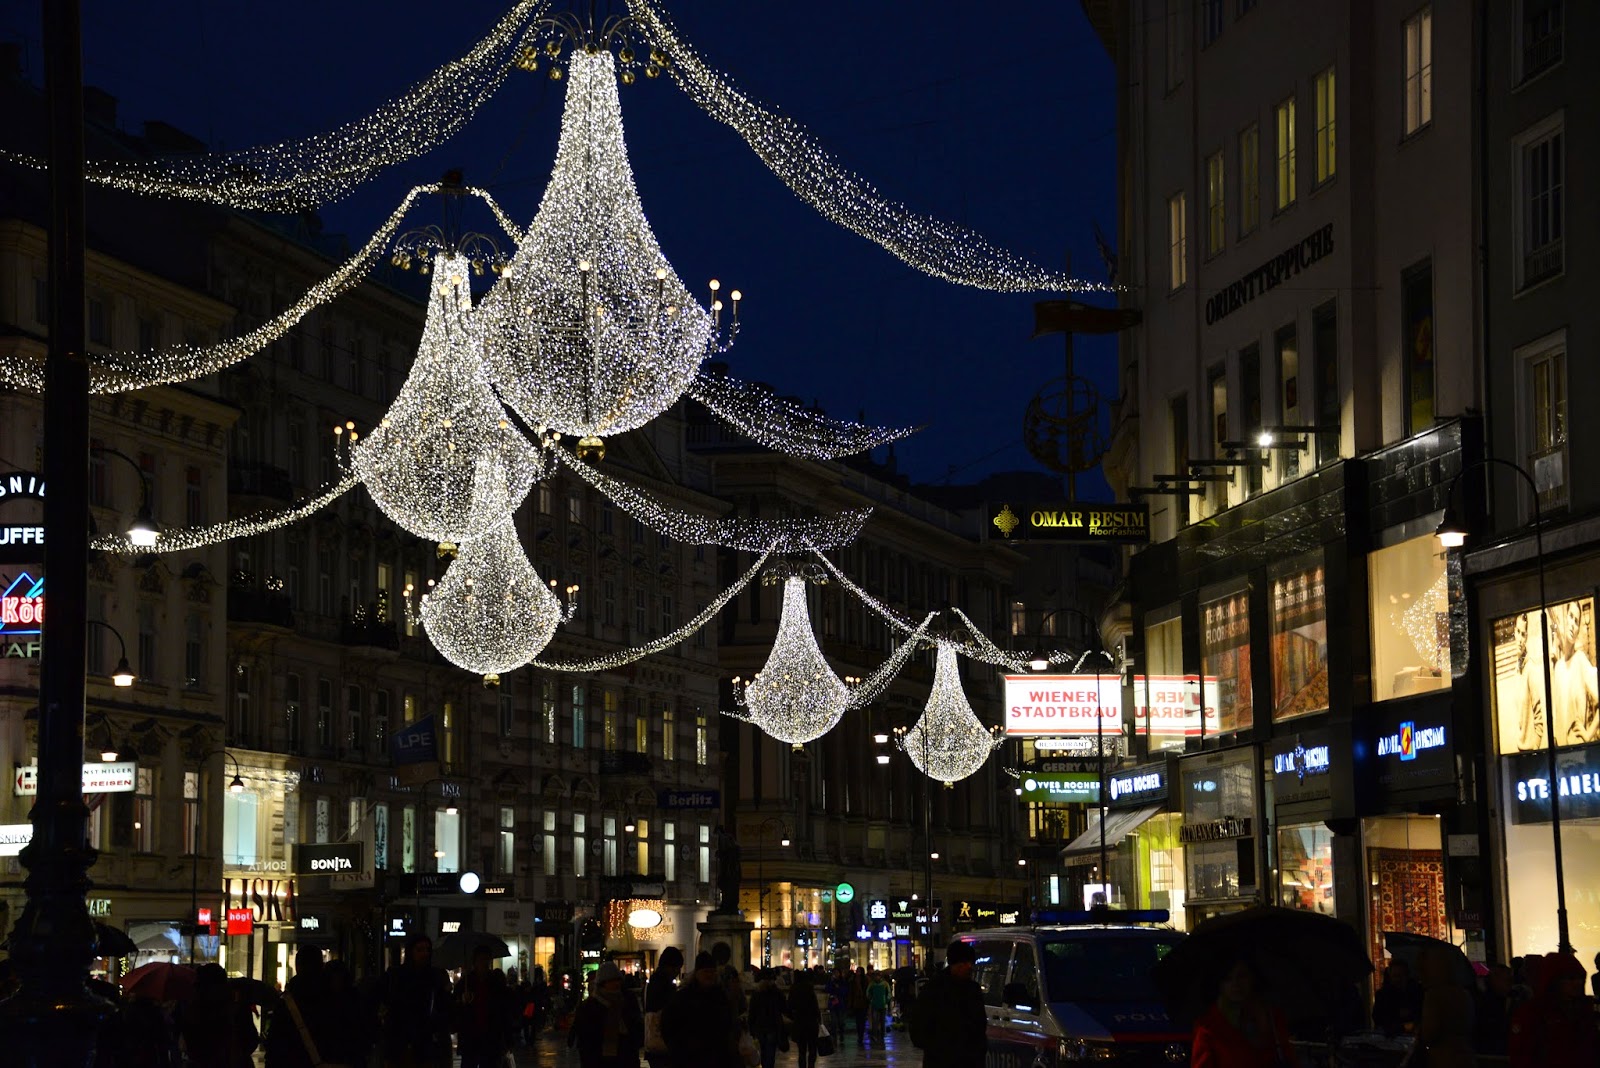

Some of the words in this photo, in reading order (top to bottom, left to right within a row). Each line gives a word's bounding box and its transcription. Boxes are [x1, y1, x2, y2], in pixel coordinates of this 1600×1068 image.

[1206, 223, 1333, 325] ORIENTTEPPICHE
[1030, 511, 1083, 527] OMAR
[1089, 512, 1145, 527] BESIM
[1089, 527, 1146, 536] FloorFashion
[1029, 691, 1097, 702] WIENER
[1042, 762, 1081, 772] GERRY
[1117, 778, 1133, 794] YVES
[1134, 773, 1160, 792] ROCHER
[1518, 773, 1600, 801] STEANEL
[668, 794, 712, 806] Berlitz
[421, 876, 439, 885] IWC
[1459, 913, 1480, 921] Eton
